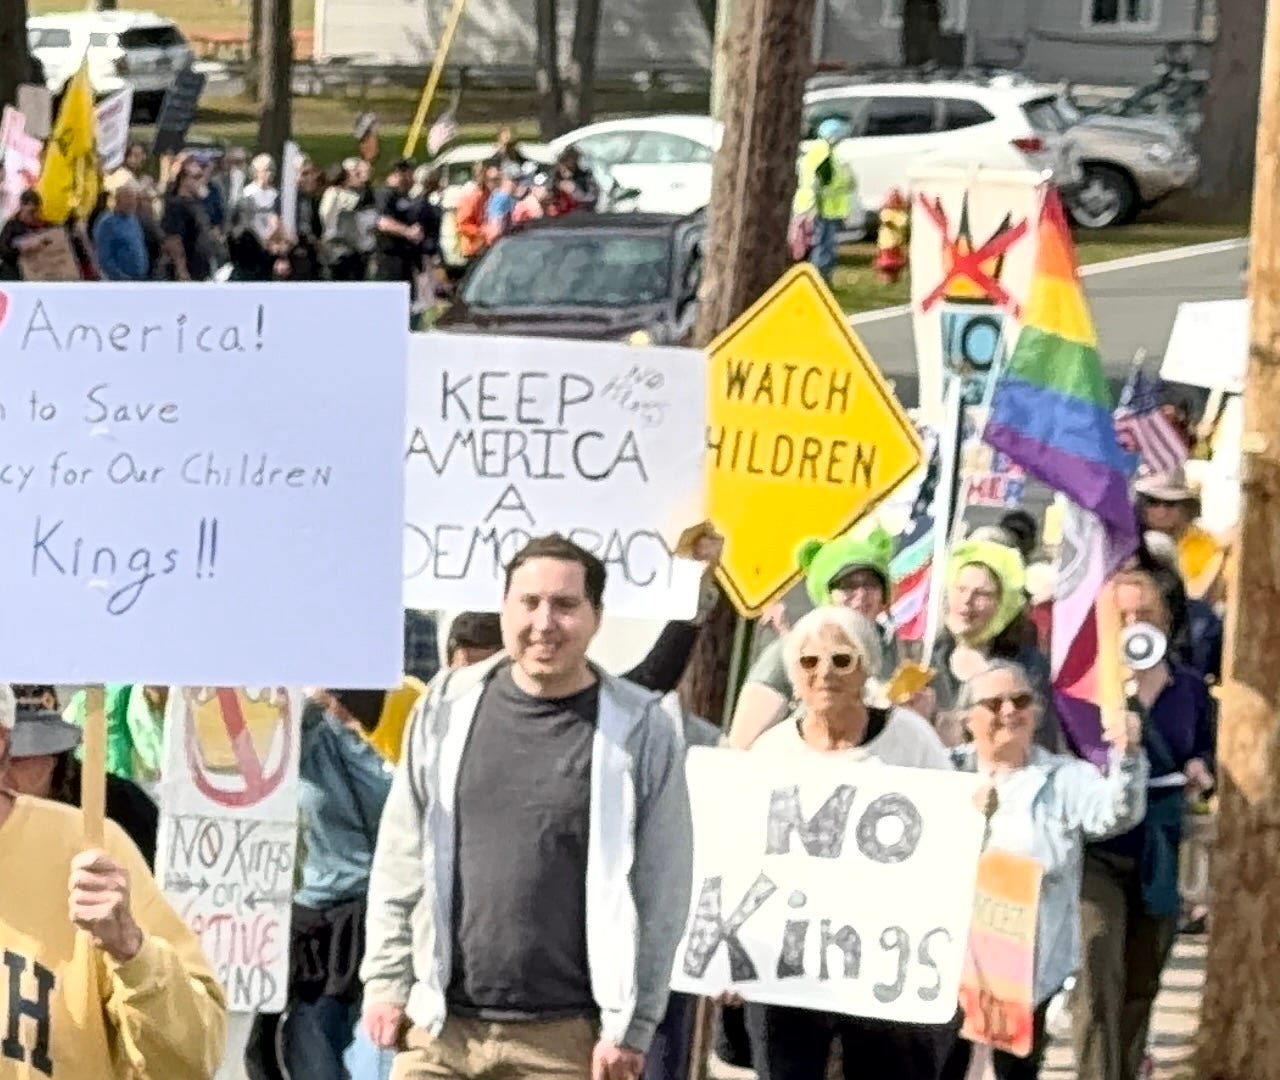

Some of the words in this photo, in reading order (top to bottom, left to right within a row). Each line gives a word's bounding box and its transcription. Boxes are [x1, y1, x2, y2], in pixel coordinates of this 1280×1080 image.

[21, 299, 266, 354] America!
[28, 390, 57, 422] to
[83, 382, 180, 425] Save
[441, 370, 594, 425] KEEP
[726, 357, 852, 414] WATCH
[49, 450, 92, 488] for
[107, 452, 166, 485] Our
[404, 426, 648, 482] AMERICA
[705, 425, 876, 489] HILDREN
[484, 483, 536, 526] A
[30, 515, 219, 616] Kings!!
[168, 819, 222, 869] NO
[765, 784, 924, 864] NO
[682, 870, 953, 1003] Kings
